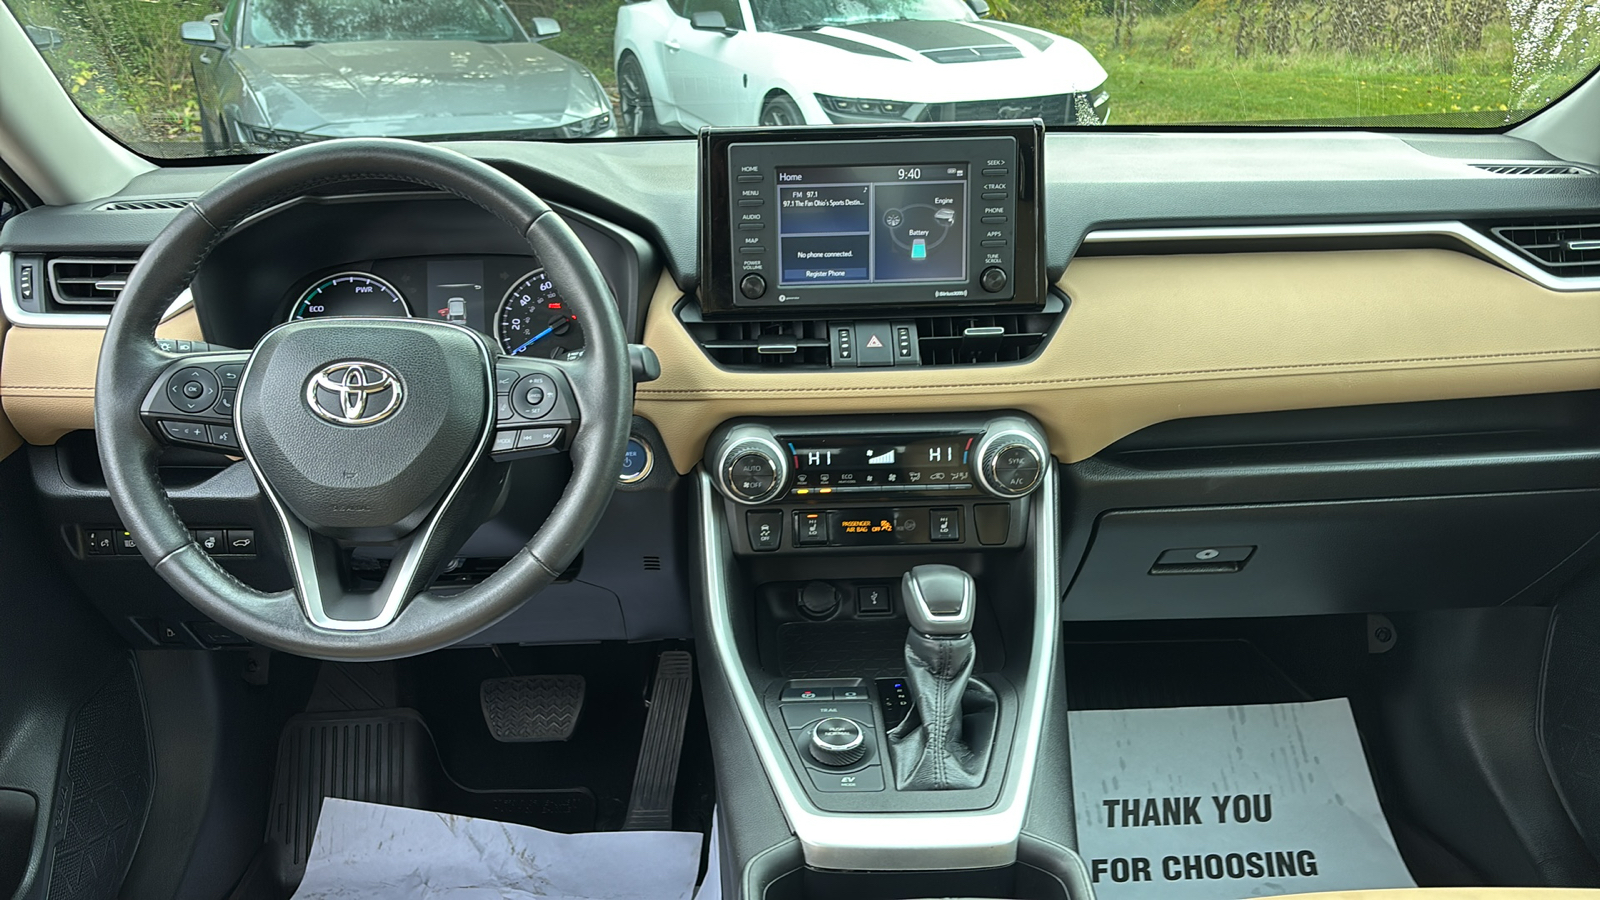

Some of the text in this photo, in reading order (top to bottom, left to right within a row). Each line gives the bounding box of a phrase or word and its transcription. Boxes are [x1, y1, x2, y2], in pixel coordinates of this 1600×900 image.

[780, 173, 803, 181] Home
[898, 168, 921, 180] 9:40
[829, 200, 845, 208] Sports
[934, 197, 953, 205] Engine
[908, 229, 929, 237] Battery
[807, 251, 823, 259] phone
[824, 250, 853, 258] connected.
[805, 270, 827, 278] Register
[540, 281, 552, 291] 60
[520, 294, 531, 307] 40
[308, 305, 324, 313] ECO
[512, 318, 521, 330] 20
[1103, 794, 1272, 828] THANK YOU
[1091, 850, 1318, 883] FOR CHOOSING
